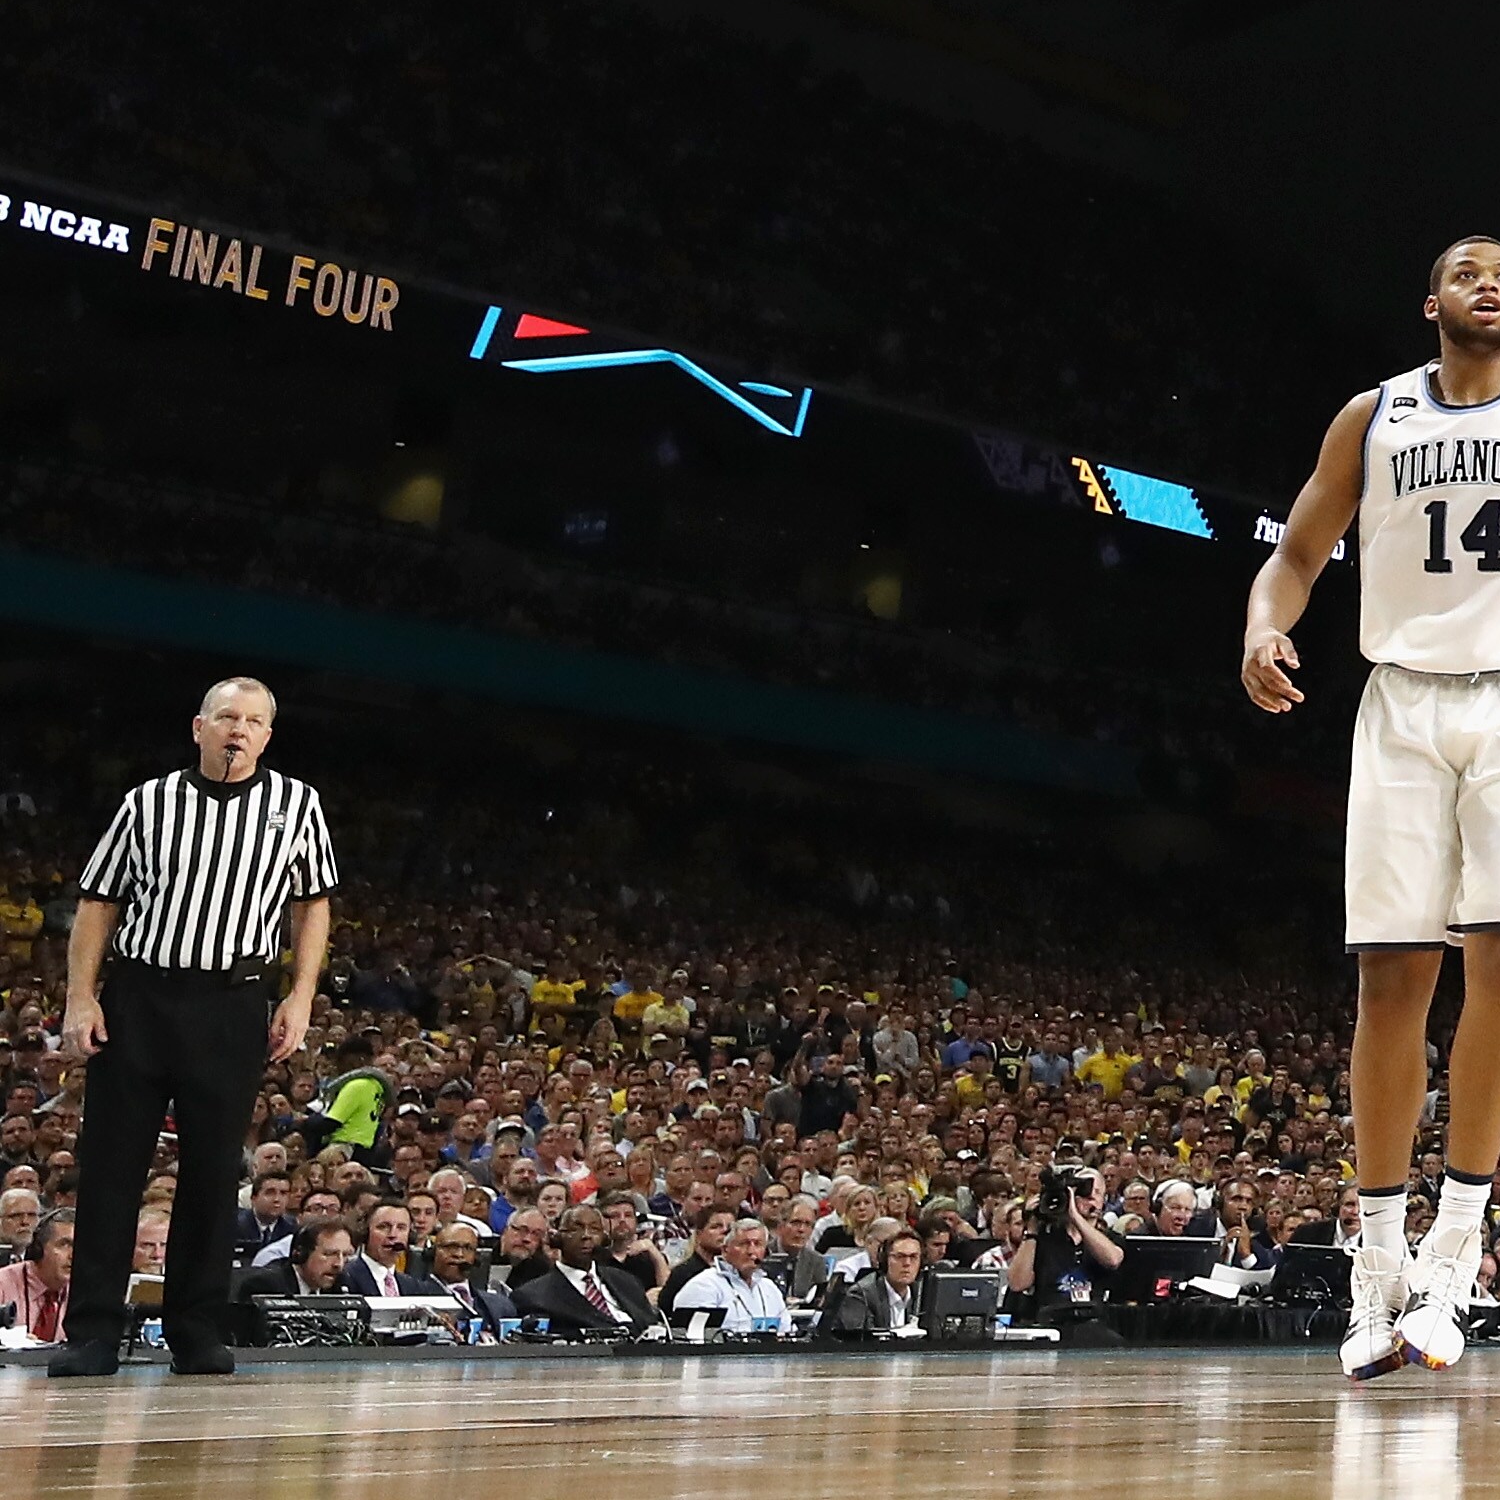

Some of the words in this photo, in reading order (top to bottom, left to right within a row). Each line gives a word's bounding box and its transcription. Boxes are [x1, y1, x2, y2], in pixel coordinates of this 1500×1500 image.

[20, 201, 129, 252] NCAA
[141, 217, 269, 301] FINAL
[285, 255, 400, 332] FOUR
